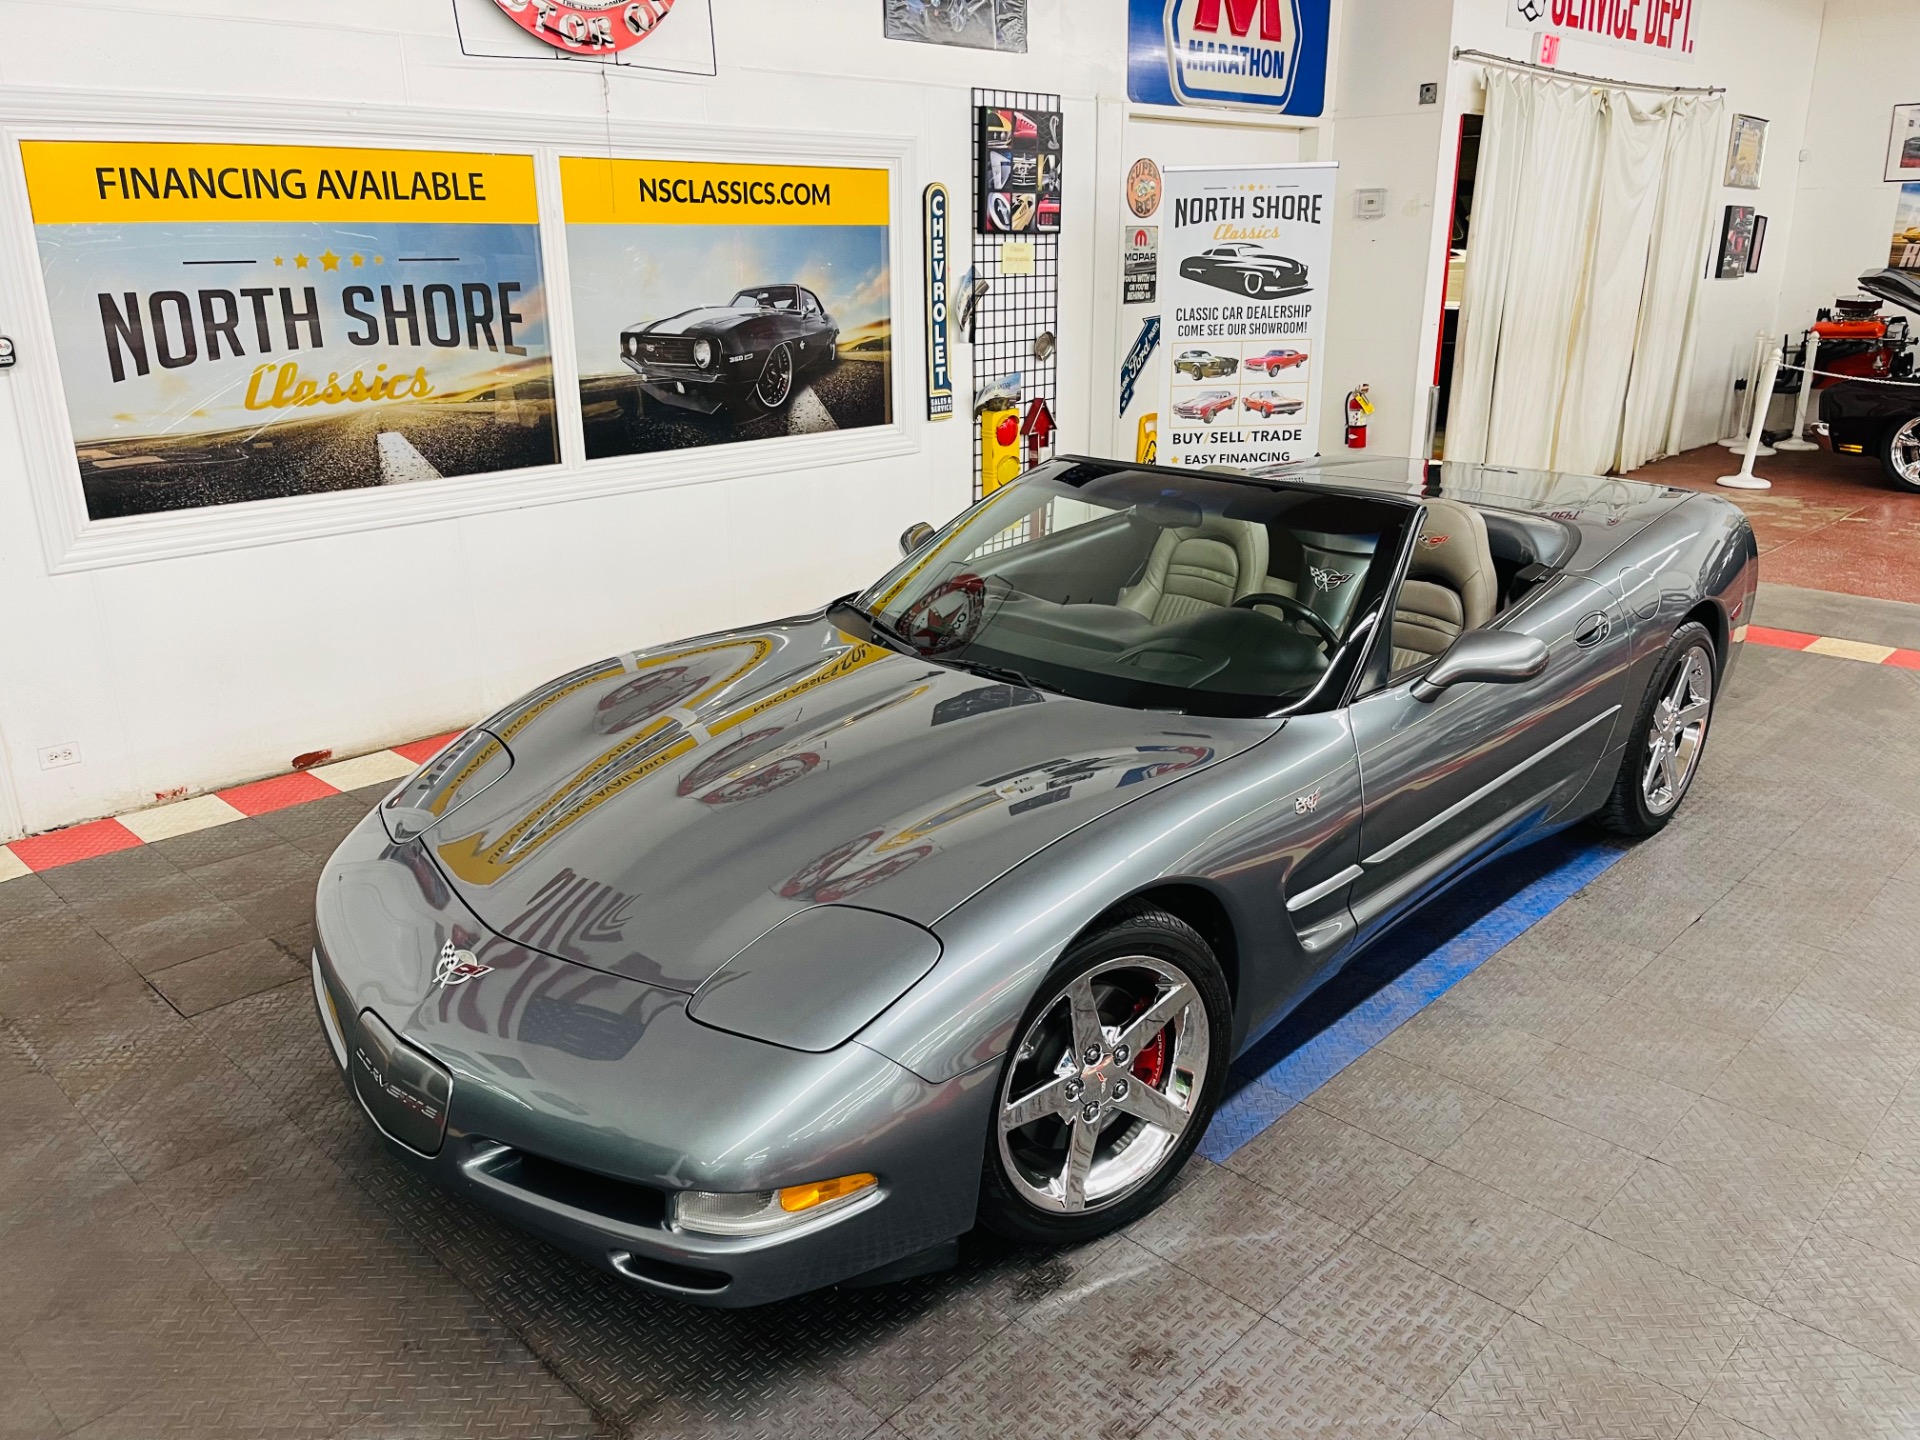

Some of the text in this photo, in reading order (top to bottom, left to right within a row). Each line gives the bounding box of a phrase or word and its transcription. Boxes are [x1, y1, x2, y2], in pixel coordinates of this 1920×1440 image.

[1186, 39, 1285, 80] MARATHON
[95, 167, 486, 202] FINANCING AVAILABLE
[639, 177, 831, 206] NSCLASSICS.COM
[1174, 194, 1323, 229] NORTH SHORE
[1212, 223, 1281, 241] Classics
[1124, 252, 1157, 262] MOPAR
[931, 195, 947, 386] CHEVROLET
[1175, 304, 1312, 322] CLASSIC CAR DEALERSHIP
[1177, 321, 1308, 337] COME SEE OUR SHOWROOM!
[98, 281, 528, 383] NORTH SHORE
[1128, 336, 1151, 379] Ford
[244, 362, 436, 411] Classics
[1184, 451, 1290, 465] EASY FINANCING
[1151, 1029, 1163, 1087] ORVETTE
[355, 1047, 438, 1119] CORVETTE
